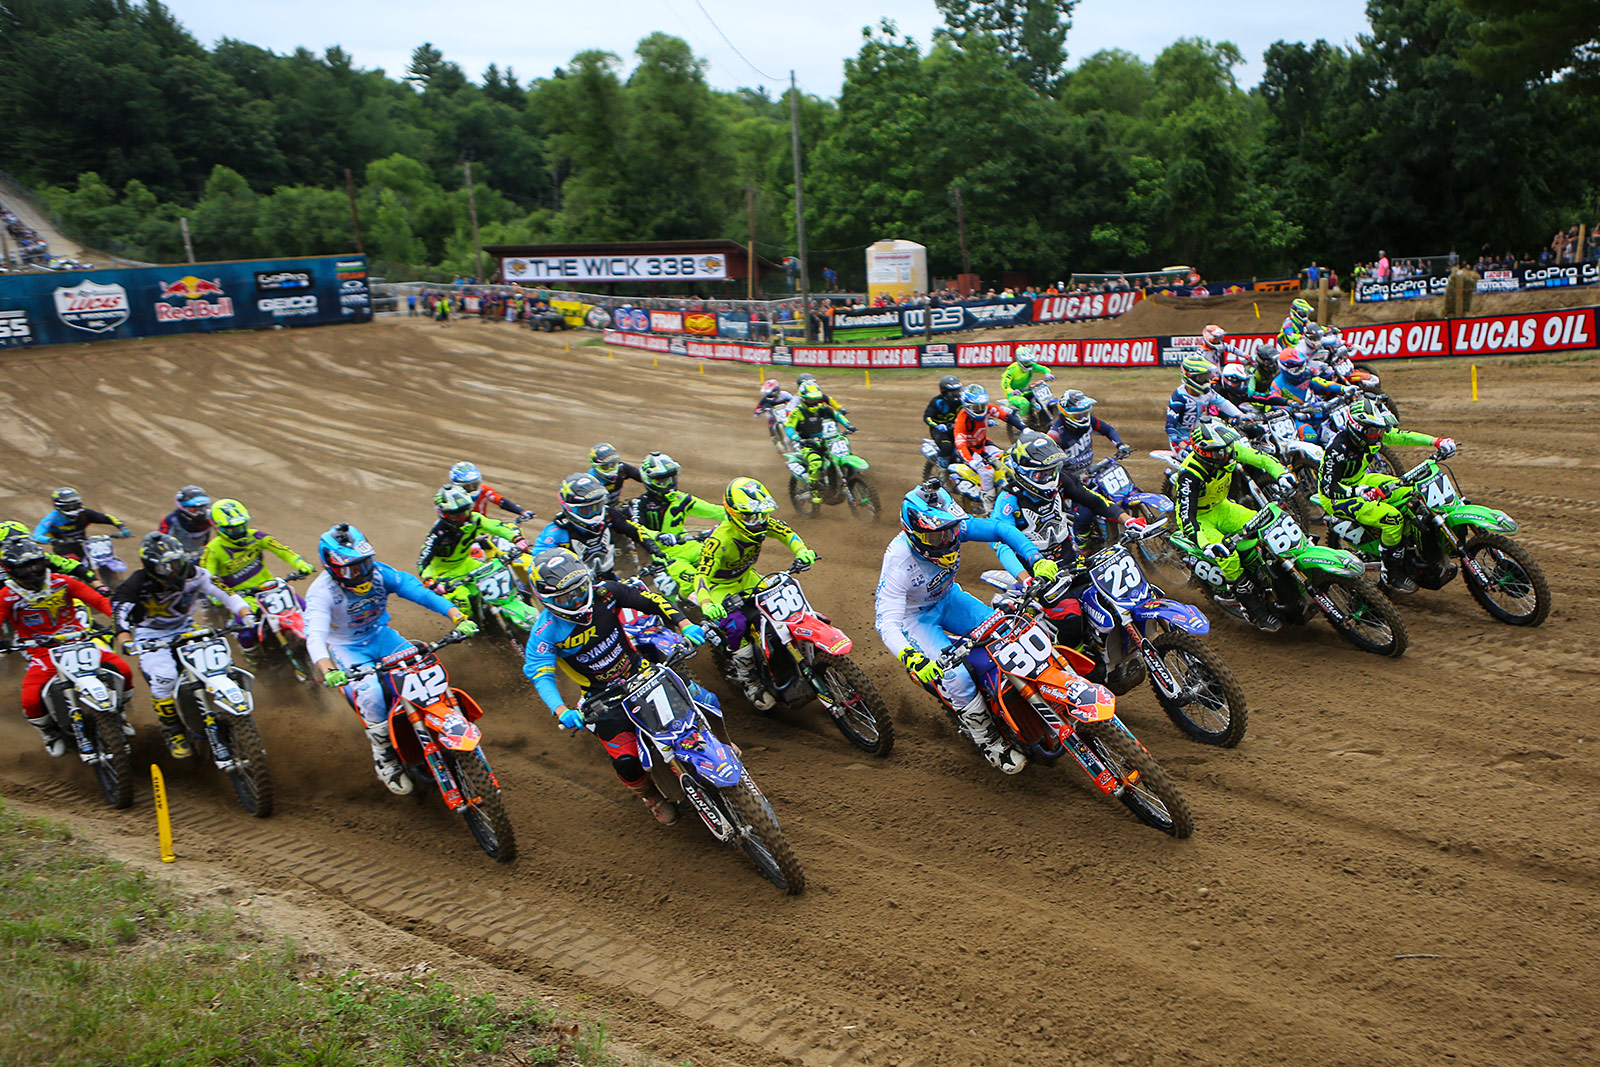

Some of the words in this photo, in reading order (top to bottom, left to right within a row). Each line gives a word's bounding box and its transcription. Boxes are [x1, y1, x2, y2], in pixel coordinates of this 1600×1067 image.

[530, 259, 577, 276] THE
[583, 258, 641, 276] WICK
[647, 257, 696, 276] 338
[1525, 266, 1577, 280] GoPro
[1362, 284, 1389, 295] GoPro
[1390, 280, 1427, 292] GoPro
[67, 297, 121, 311] LUCAS
[154, 302, 196, 322] Red
[196, 297, 234, 319] Bull
[258, 296, 317, 312] GEICO
[1040, 295, 1104, 320] LUCAS
[1108, 292, 1137, 314] OIL
[835, 312, 899, 327] Kawasaki
[1454, 318, 1537, 351] LUCAS
[1543, 314, 1589, 346] OIL
[1406, 325, 1444, 352] OIL
[794, 349, 816, 364] LUCAS
[818, 350, 830, 364] OIL
[832, 349, 856, 364] LUCAS
[857, 350, 869, 365] OIL
[871, 349, 900, 365] LUCAS
[901, 348, 918, 365] OIL
[958, 346, 993, 364] LUCAS
[995, 344, 1014, 363] OIL
[1057, 343, 1079, 363] OIL
[1084, 342, 1130, 363] LUCAS
[1131, 341, 1155, 362] OIL
[1102, 466, 1130, 494] 69
[1427, 474, 1456, 508] 44
[1267, 515, 1301, 555] 66
[1333, 520, 1365, 546] 44
[478, 570, 511, 600] 37
[1105, 555, 1141, 599] 23
[1195, 560, 1225, 586] 66
[264, 588, 295, 614] 31
[766, 584, 804, 622] 58
[706, 629, 722, 647] 58
[60, 647, 102, 674] 49
[188, 644, 232, 673] 16
[998, 625, 1052, 678] 30
[401, 664, 448, 702] 42
[645, 684, 675, 727] 1
[685, 785, 722, 826] DUNLOP
